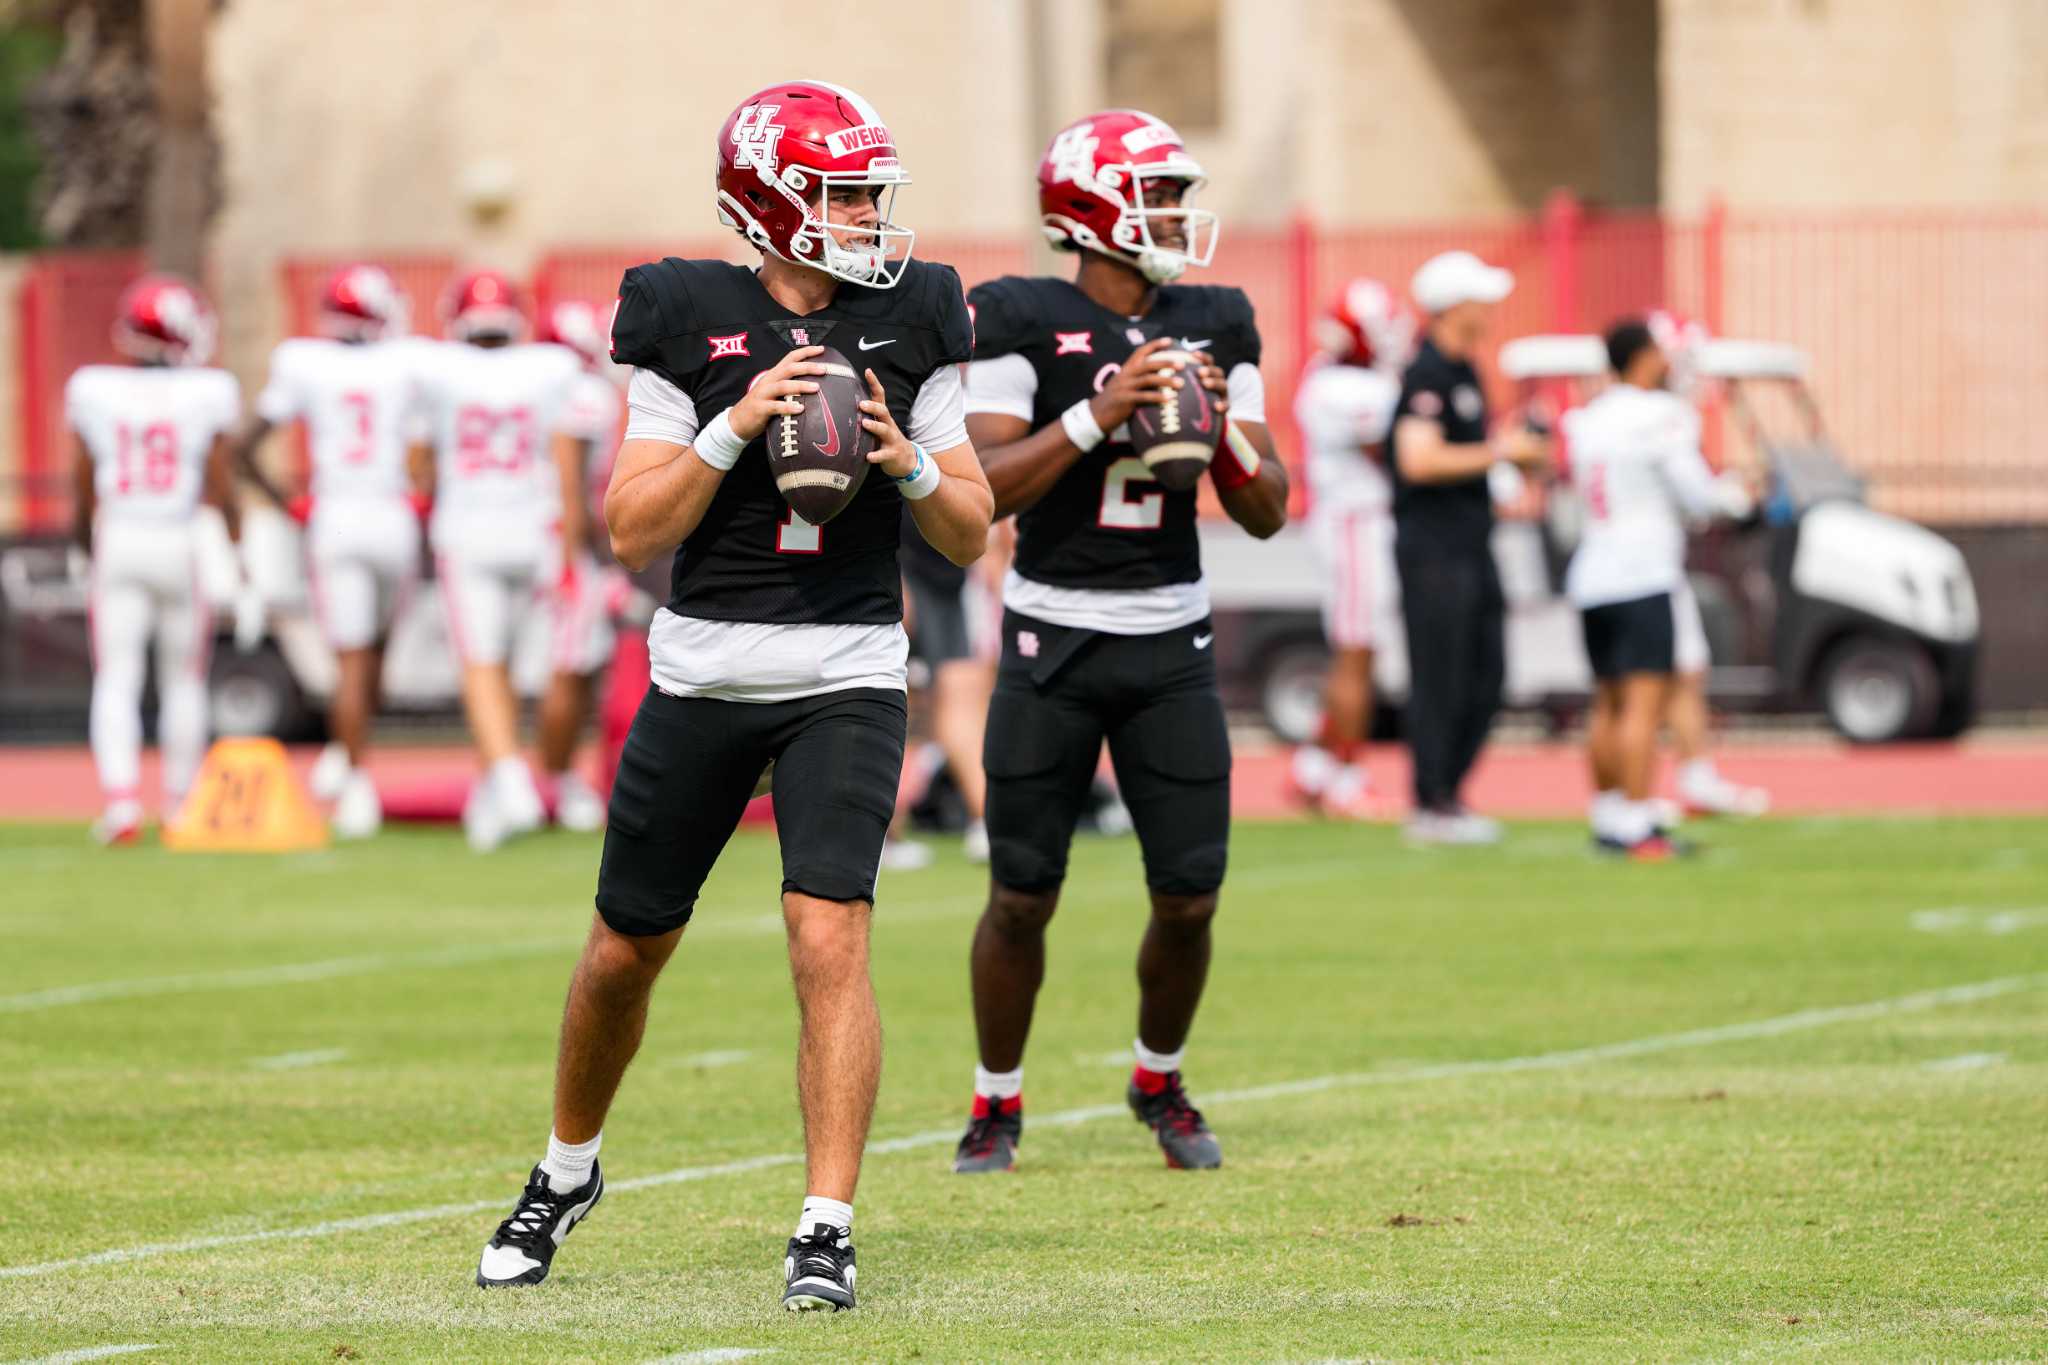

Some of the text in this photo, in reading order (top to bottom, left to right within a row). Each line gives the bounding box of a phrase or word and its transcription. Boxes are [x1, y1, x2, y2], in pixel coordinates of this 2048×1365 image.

[707, 331, 751, 362] XII
[116, 419, 178, 494] 18
[1097, 424, 1164, 528] 2
